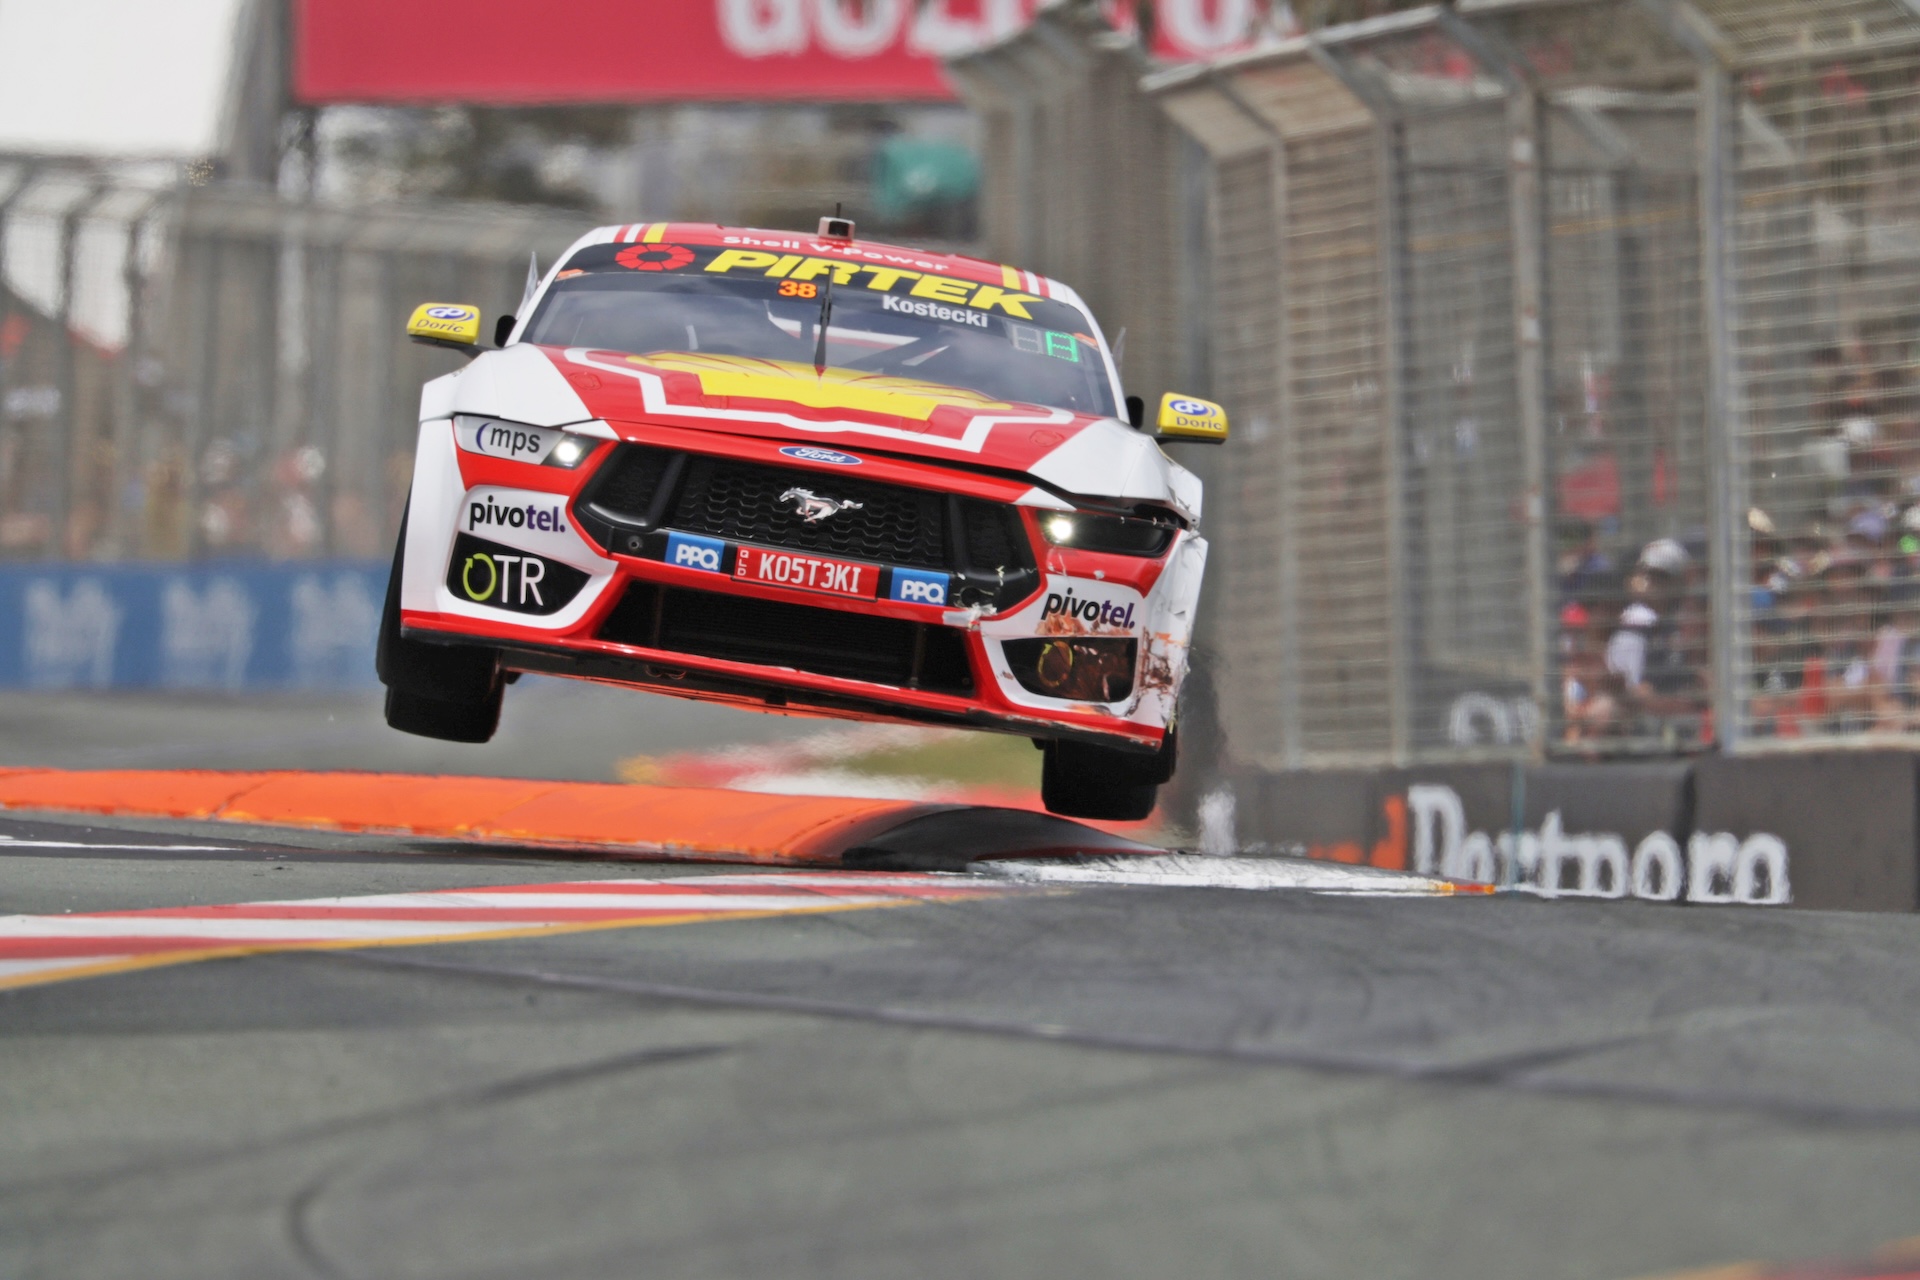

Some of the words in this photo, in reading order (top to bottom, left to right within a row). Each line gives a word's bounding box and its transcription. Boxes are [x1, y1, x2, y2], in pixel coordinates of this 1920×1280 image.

[723, 236, 800, 249] Shell
[810, 243, 949, 271] V-Power
[704, 249, 1043, 319] PIRTEK
[778, 281, 816, 298] 38
[882, 295, 988, 328] Kostecki
[416, 319, 464, 333] Doric
[1176, 416, 1223, 431] Doric
[490, 427, 541, 454] mps
[792, 448, 847, 465] Ford
[675, 544, 719, 570] PPQ
[737, 550, 749, 576] QLD
[462, 553, 544, 607] OTR
[900, 580, 944, 604] PPQ
